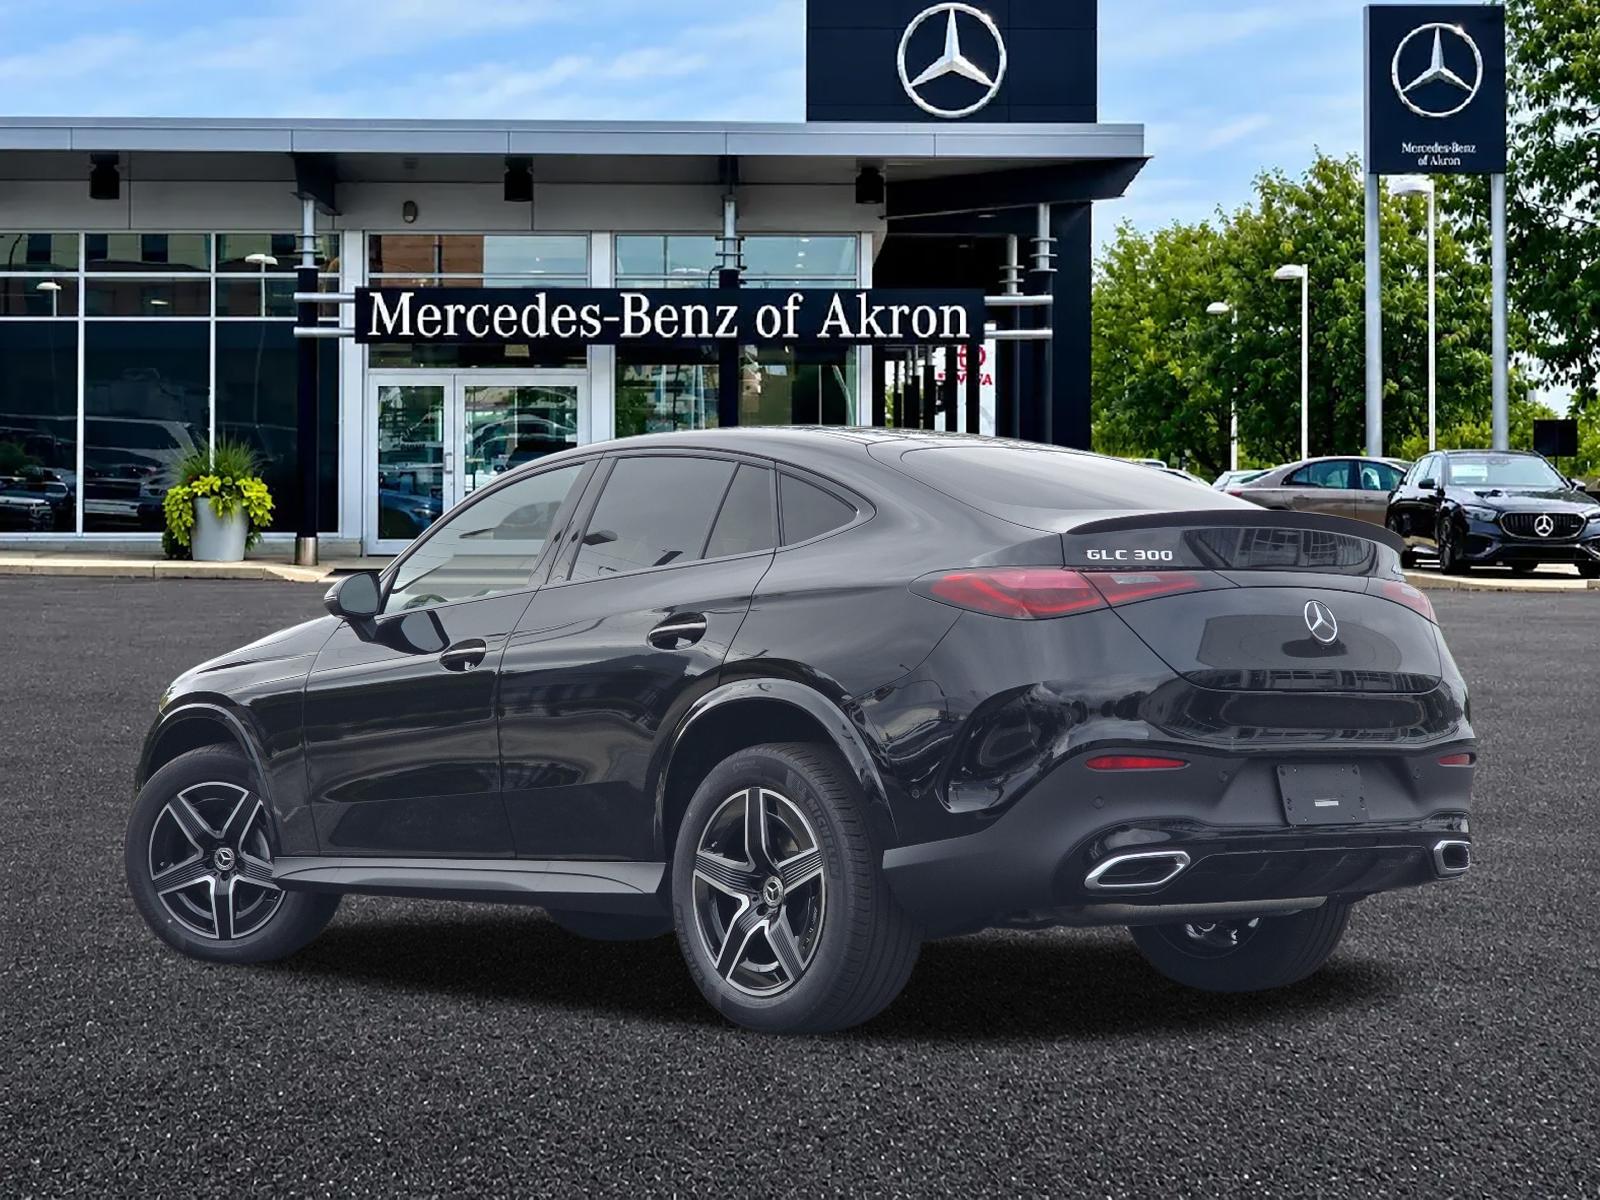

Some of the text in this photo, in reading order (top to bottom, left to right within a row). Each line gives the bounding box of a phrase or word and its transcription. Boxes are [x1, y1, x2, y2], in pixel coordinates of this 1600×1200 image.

[1401, 141, 1477, 153] Mercedes-Benz
[1417, 154, 1461, 166] of Akron
[367, 291, 971, 339] Mercedes-Benz of Akron
[1086, 549, 1173, 561] GLC 300
